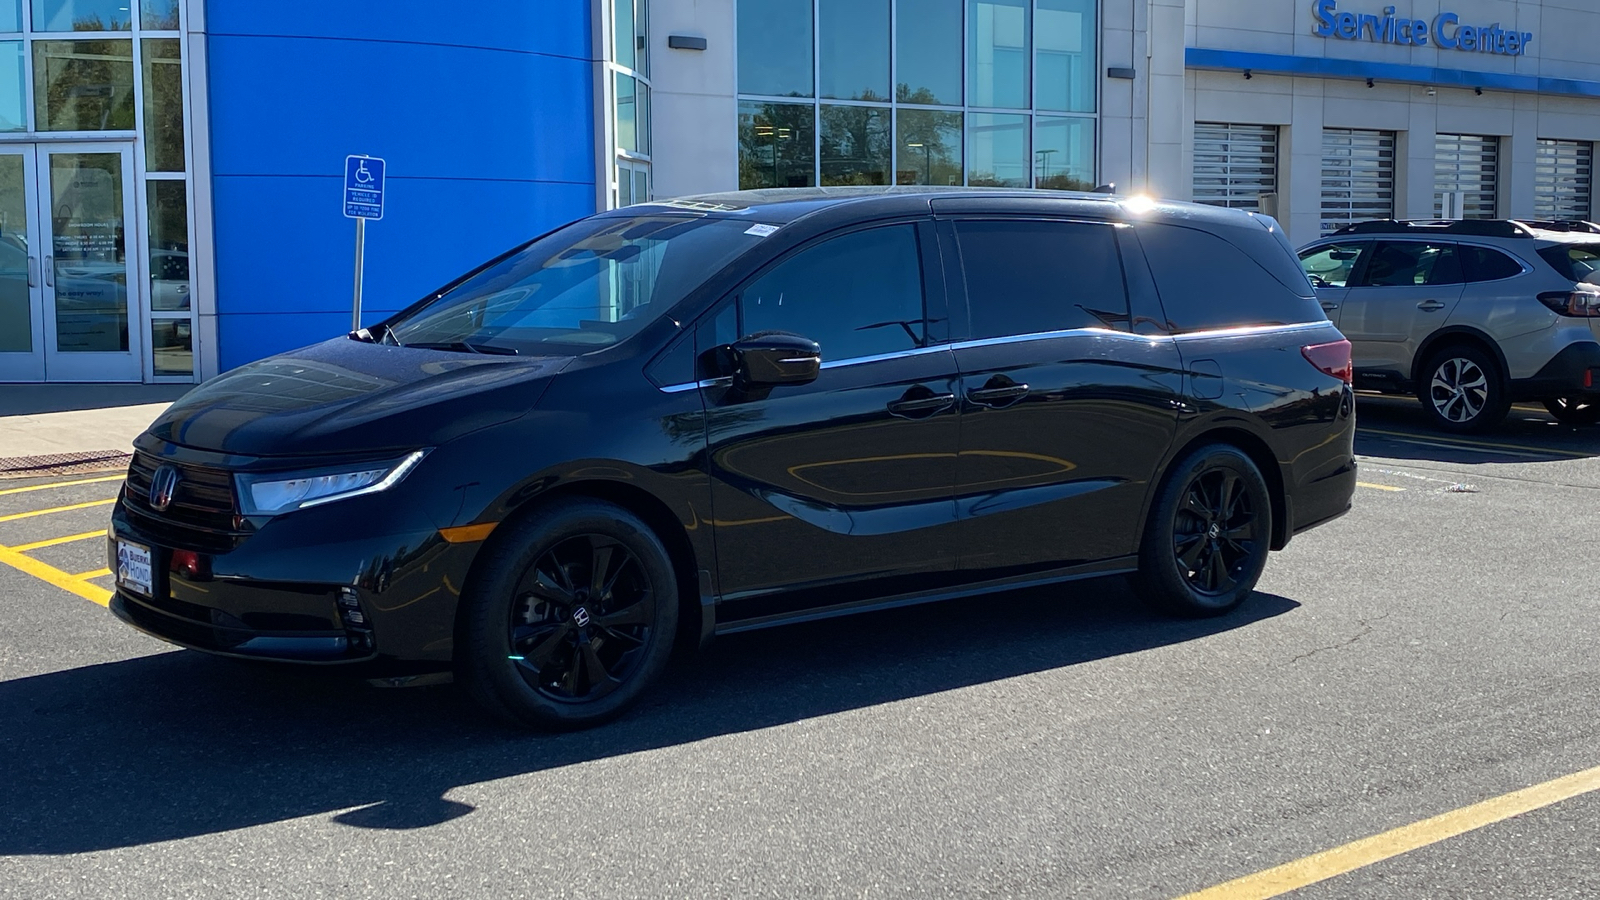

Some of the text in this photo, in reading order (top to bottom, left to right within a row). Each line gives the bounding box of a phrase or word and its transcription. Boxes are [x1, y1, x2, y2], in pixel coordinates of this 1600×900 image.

[1312, 0, 1533, 55] Service Center
[129, 550, 151, 566] BUERKL
